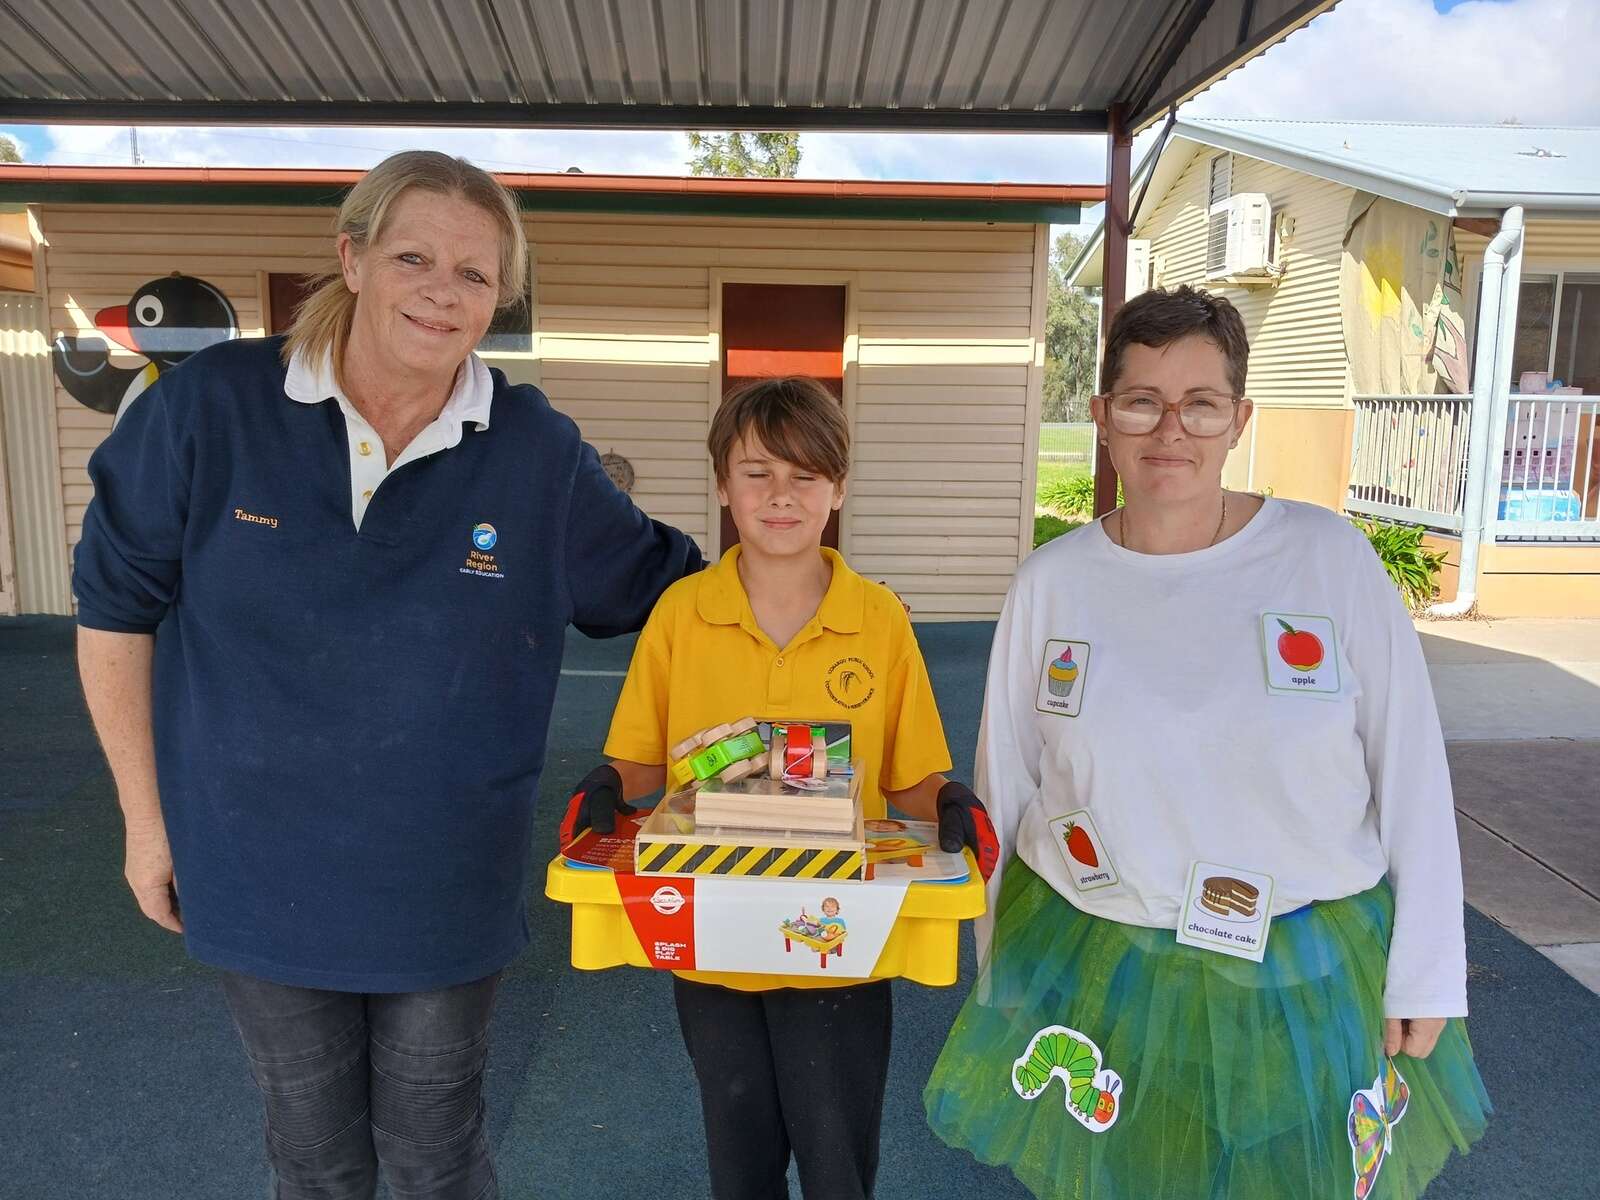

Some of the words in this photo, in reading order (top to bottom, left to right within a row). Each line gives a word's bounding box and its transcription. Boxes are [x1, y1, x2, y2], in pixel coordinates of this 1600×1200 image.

[234, 508, 278, 529] Tammy
[470, 550, 494, 562] River
[466, 558, 498, 571] Region
[475, 569, 505, 579] EDUCATION
[1291, 675, 1317, 687] apple
[1046, 699, 1070, 709] cupcake
[1080, 872, 1110, 884] strawberry
[1188, 922, 1233, 940] chocolate
[1235, 934, 1257, 945] cake
